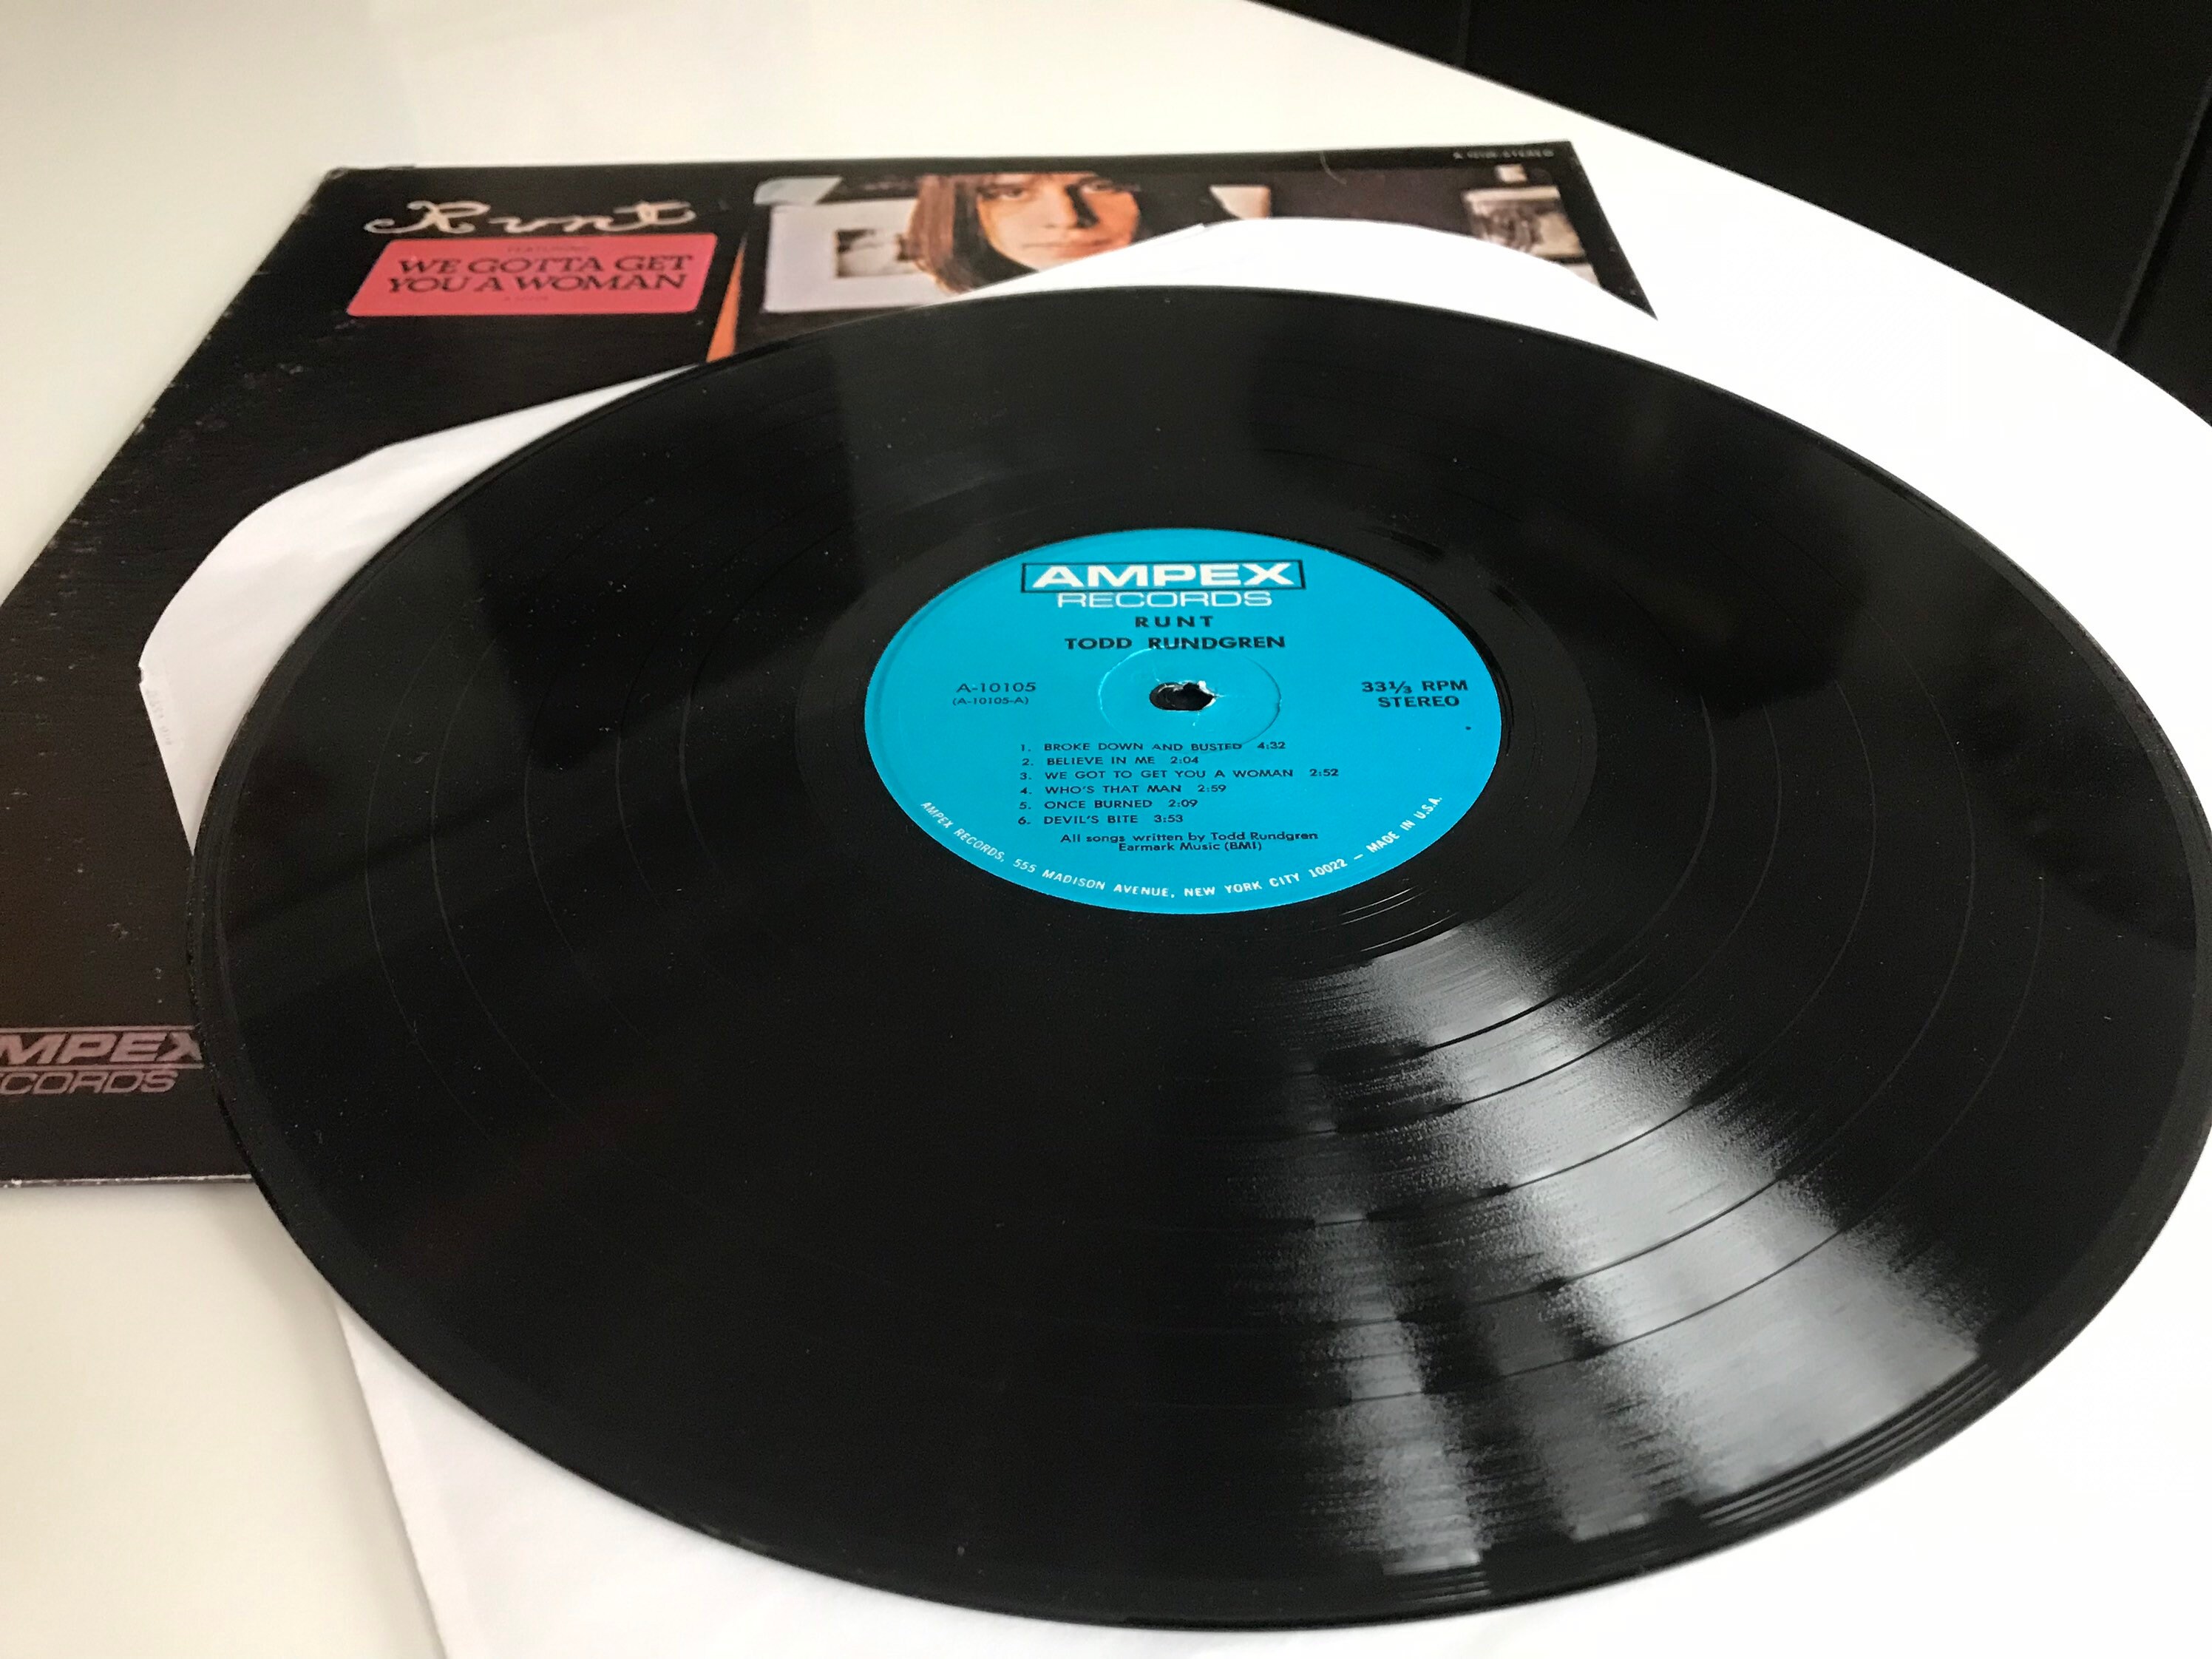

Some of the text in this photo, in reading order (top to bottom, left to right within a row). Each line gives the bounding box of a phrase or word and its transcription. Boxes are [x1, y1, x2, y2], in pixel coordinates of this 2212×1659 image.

[364, 200, 696, 234] Runt
[399, 254, 693, 274] WE GOTTA GET
[387, 274, 688, 294] YOU A WOMAN
[1033, 563, 1294, 588] AMPEX
[1056, 591, 1273, 608] RECORDS
[1135, 615, 1215, 628] RUNT
[1065, 636, 1286, 650] TODD RUNDGREN
[956, 682, 1037, 693] A-10105
[1422, 679, 1469, 691] RPM
[952, 696, 1029, 706] (A-10105-A)
[1377, 695, 1460, 708] STEREO
[1021, 742, 1286, 752] 1. BROKE DOWN AND BUSTED 4:32
[1047, 756, 1104, 765] BELIEVE
[1111, 756, 1127, 764] IN
[1135, 756, 1155, 764] ME
[1170, 756, 1198, 764] 2:04
[1020, 768, 1339, 780] 3. WE GOT TO GET YOU A WOMAN 2:52
[1020, 787, 1032, 795] 4.
[1102, 785, 1139, 793] THAT
[1147, 784, 1181, 793] MAN
[1198, 784, 1227, 793] 2:59
[1019, 799, 1198, 810] 5. ONCE BURNED 2:09
[1018, 816, 1031, 825] 6.
[1107, 815, 1139, 824] BITE
[1154, 814, 1183, 823] 3:53
[1060, 834, 1081, 843] All
[1086, 835, 1125, 844] songs
[1188, 832, 1206, 841] by
[1211, 832, 1246, 841] Todd
[1250, 832, 1319, 841] Rundgren
[921, 801, 954, 828] AMPEX
[954, 828, 1005, 863] RECORDS,
[1013, 858, 1037, 873] 555
[1042, 869, 1105, 891] MADISON
[1184, 886, 1215, 897] NEW
[1224, 881, 1263, 894] YORK
[1269, 872, 1300, 887] CITY
[1308, 858, 1348, 878] 10022
[1365, 830, 1400, 853] MADE
[1400, 819, 1416, 831] IN
[1413, 797, 1442, 819] U.S.A.
[1119, 841, 1262, 852] Earmark Music (BMI)
[0, 1032, 202, 1065] MPEX
[0, 1070, 179, 1095] CORDS
